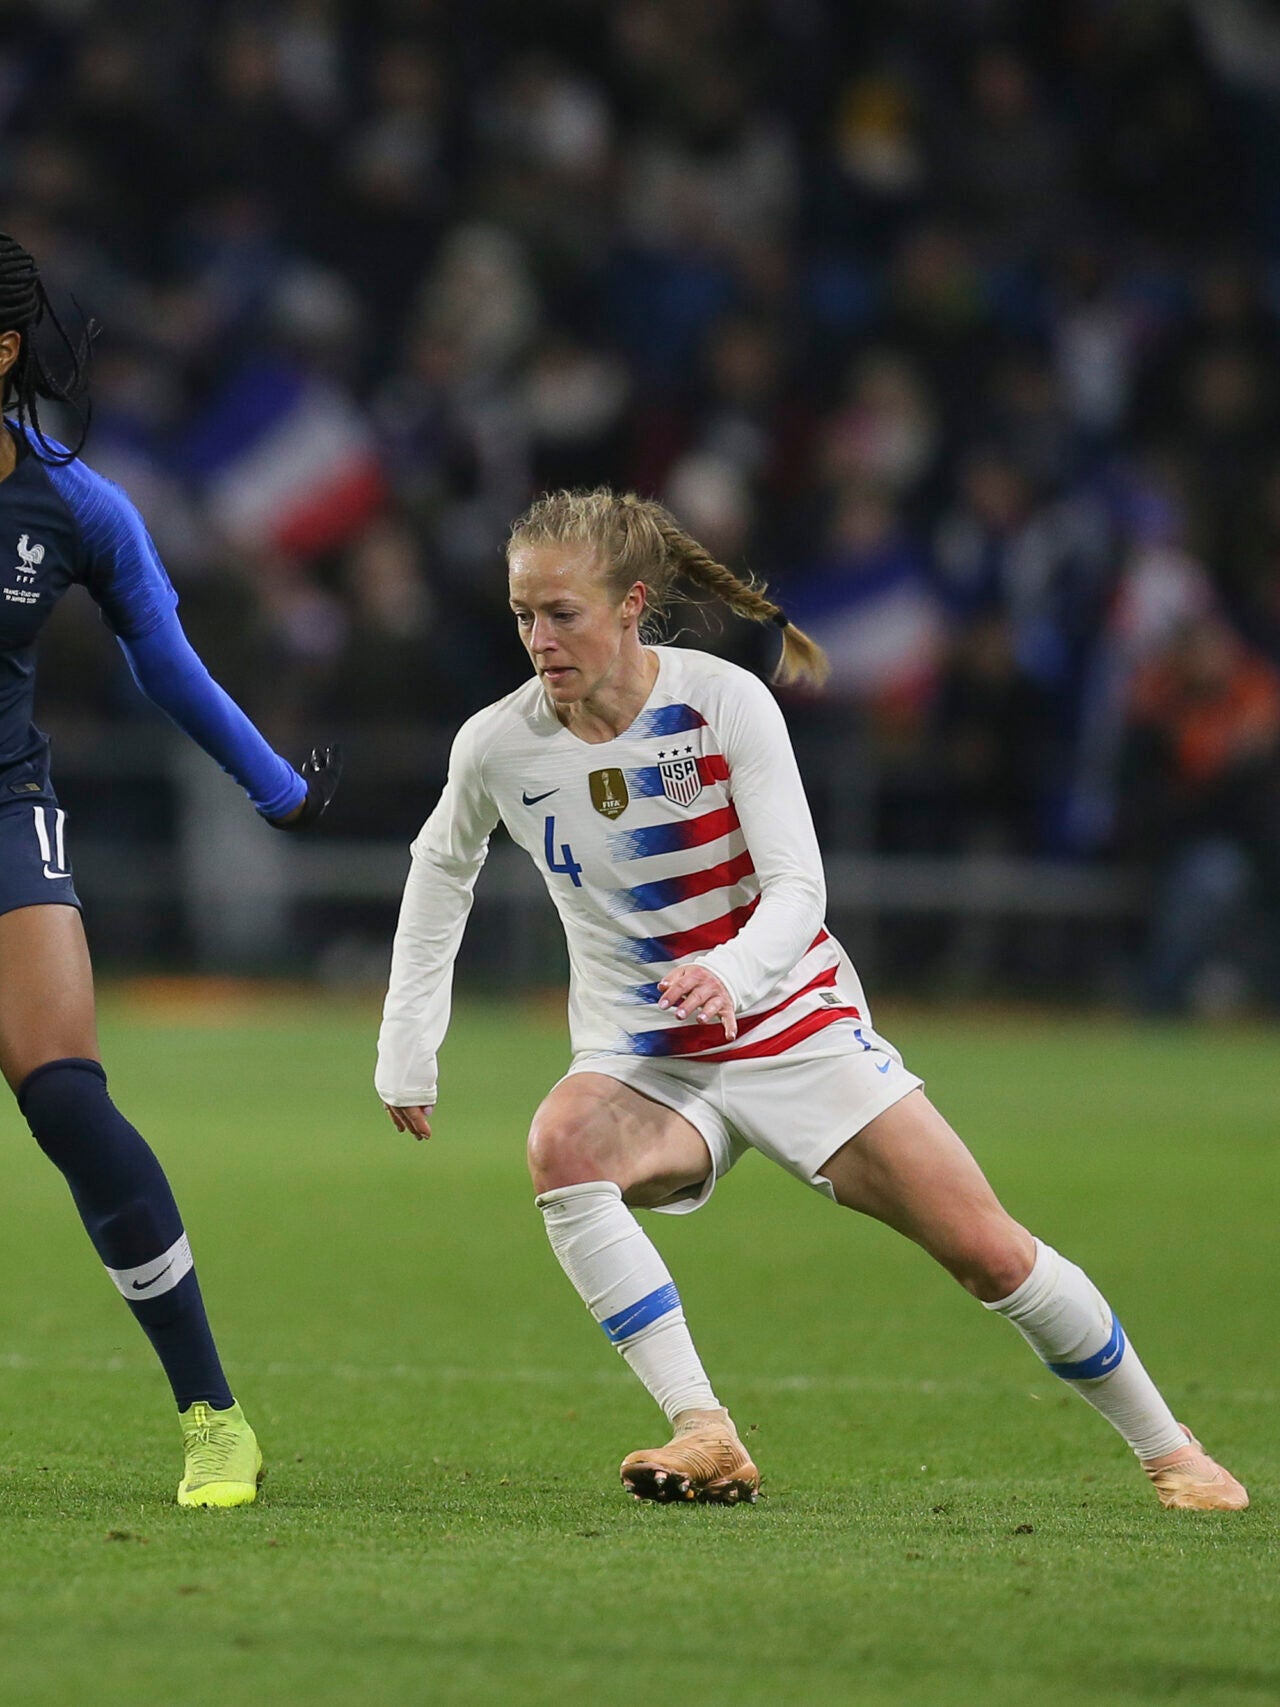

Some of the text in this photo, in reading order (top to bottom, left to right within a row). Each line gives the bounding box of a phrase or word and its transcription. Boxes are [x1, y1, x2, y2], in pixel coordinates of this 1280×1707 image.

[662, 760, 694, 780] USA
[602, 800, 620, 808] FIFA
[33, 805, 66, 870] 11
[545, 816, 582, 887] 4
